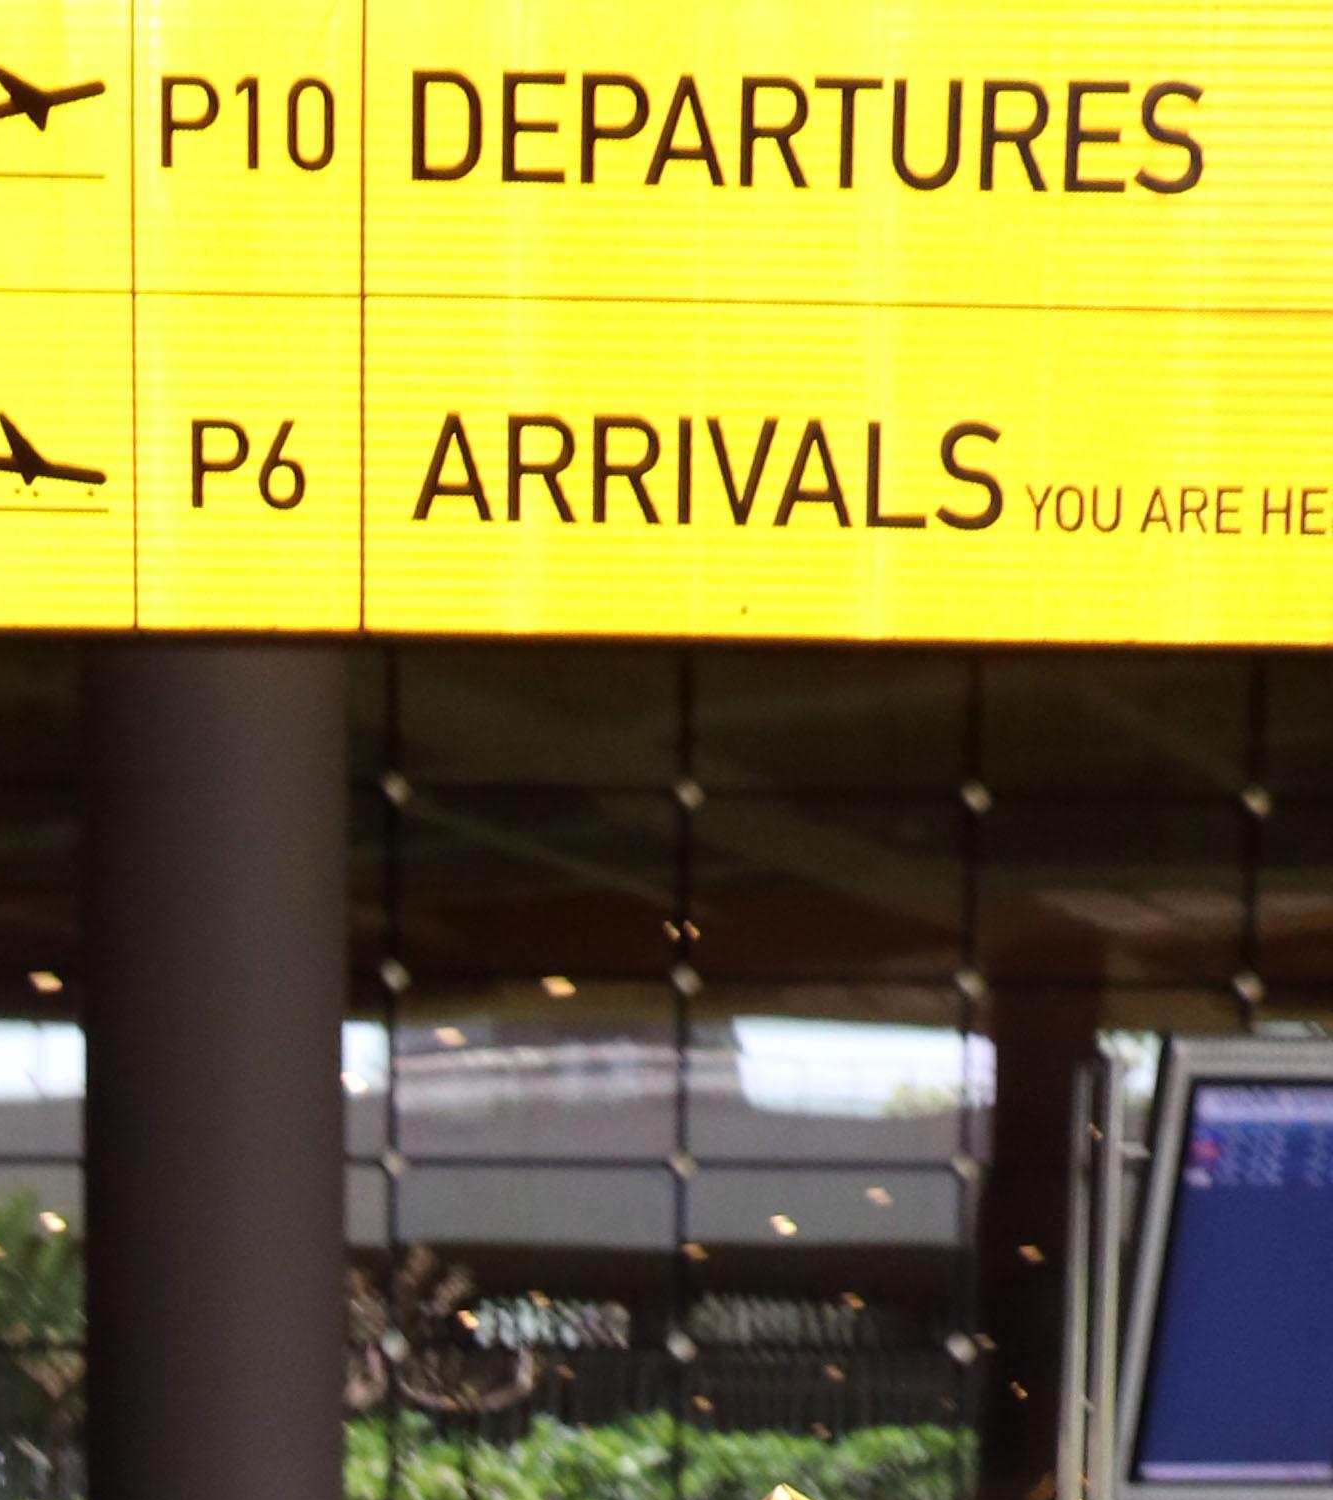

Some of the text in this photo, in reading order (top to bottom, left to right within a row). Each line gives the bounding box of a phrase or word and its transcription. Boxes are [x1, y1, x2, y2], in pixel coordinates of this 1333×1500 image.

[160, 69, 1205, 196] P10 DEPARTURES
[190, 412, 1333, 535] P6 ARRIVALS YOU ARE HE
